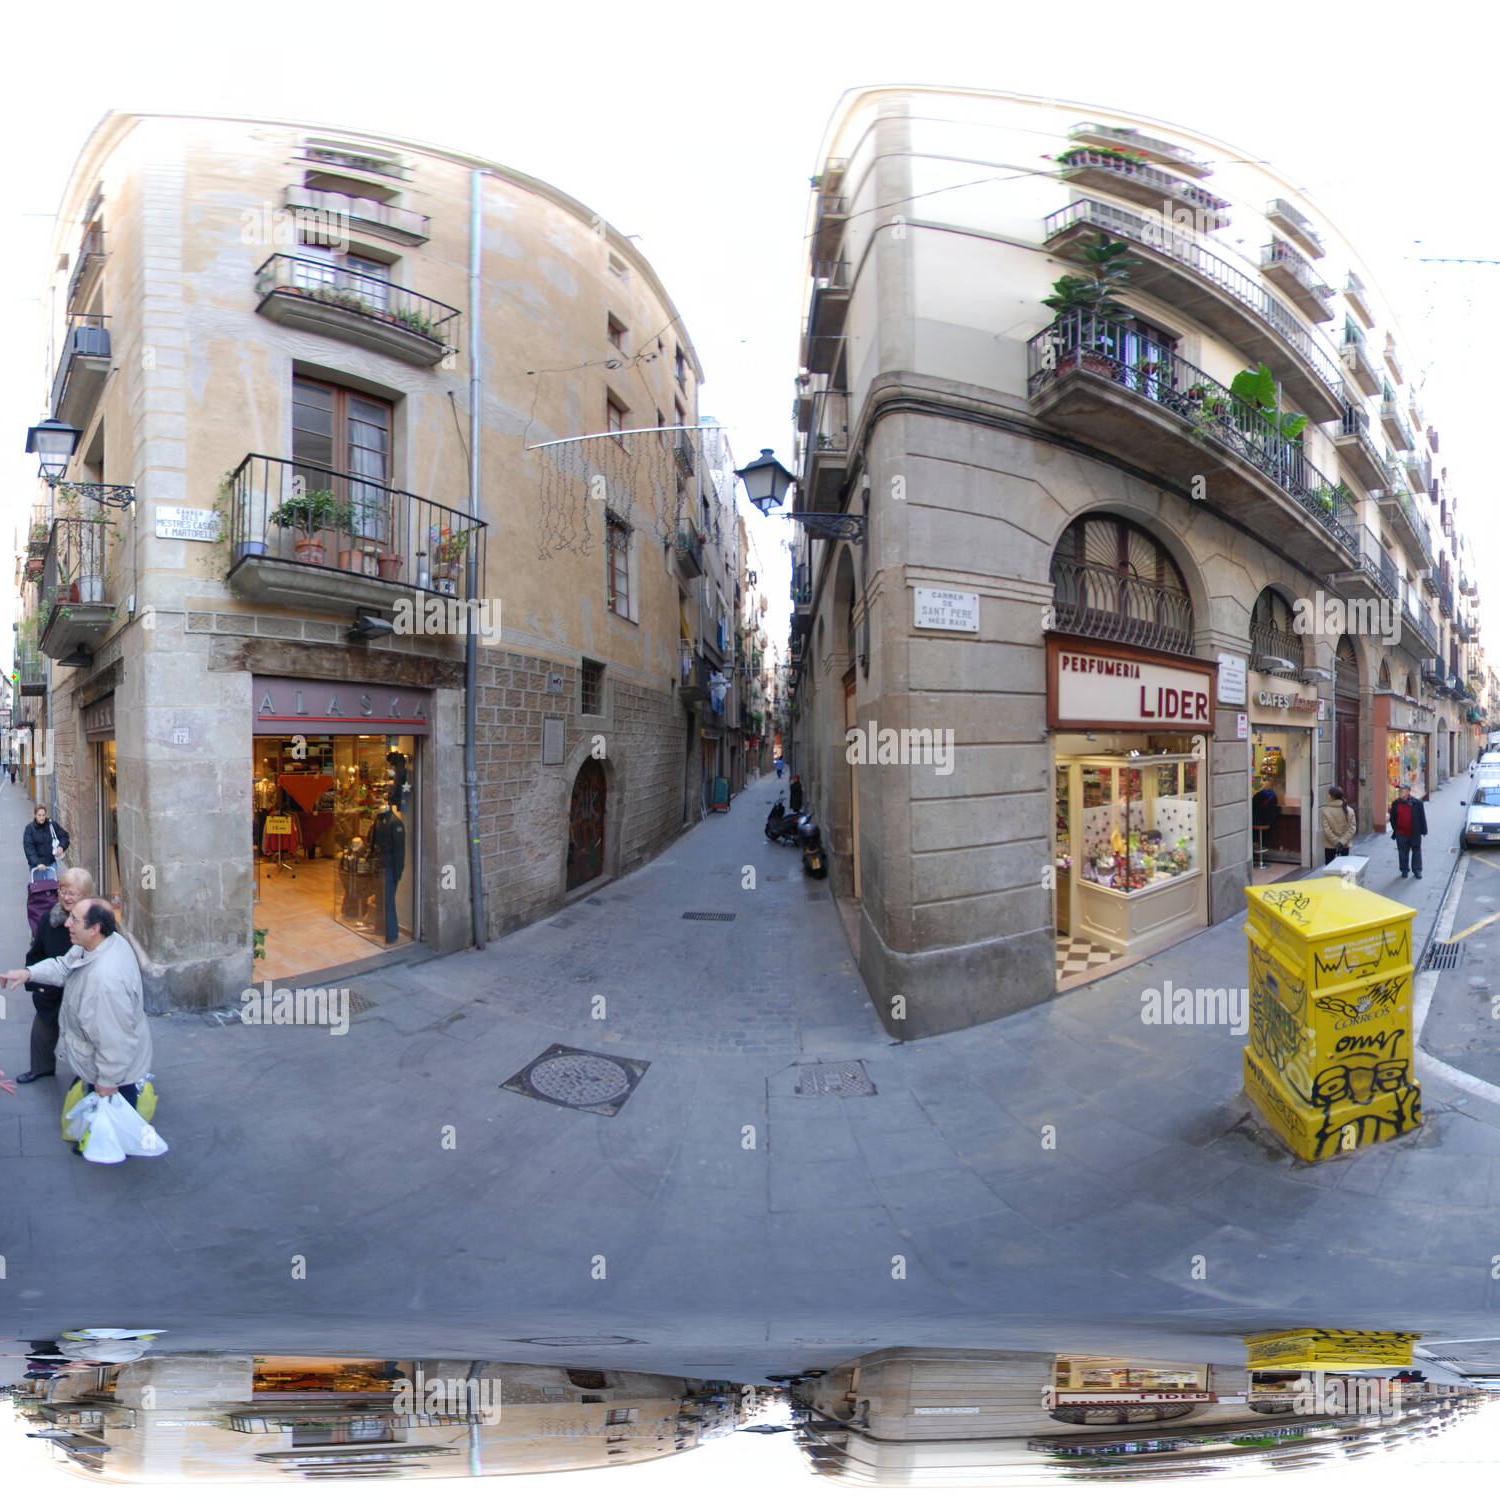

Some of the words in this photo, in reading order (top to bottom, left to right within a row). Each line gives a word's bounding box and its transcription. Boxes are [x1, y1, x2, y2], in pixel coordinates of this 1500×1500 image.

[922, 606, 946, 617] SANT
[950, 608, 973, 620] PERE
[1062, 655, 1141, 680] PERFUMERIA
[257, 689, 429, 720] ALASKA
[1140, 685, 1209, 721] LIDER
